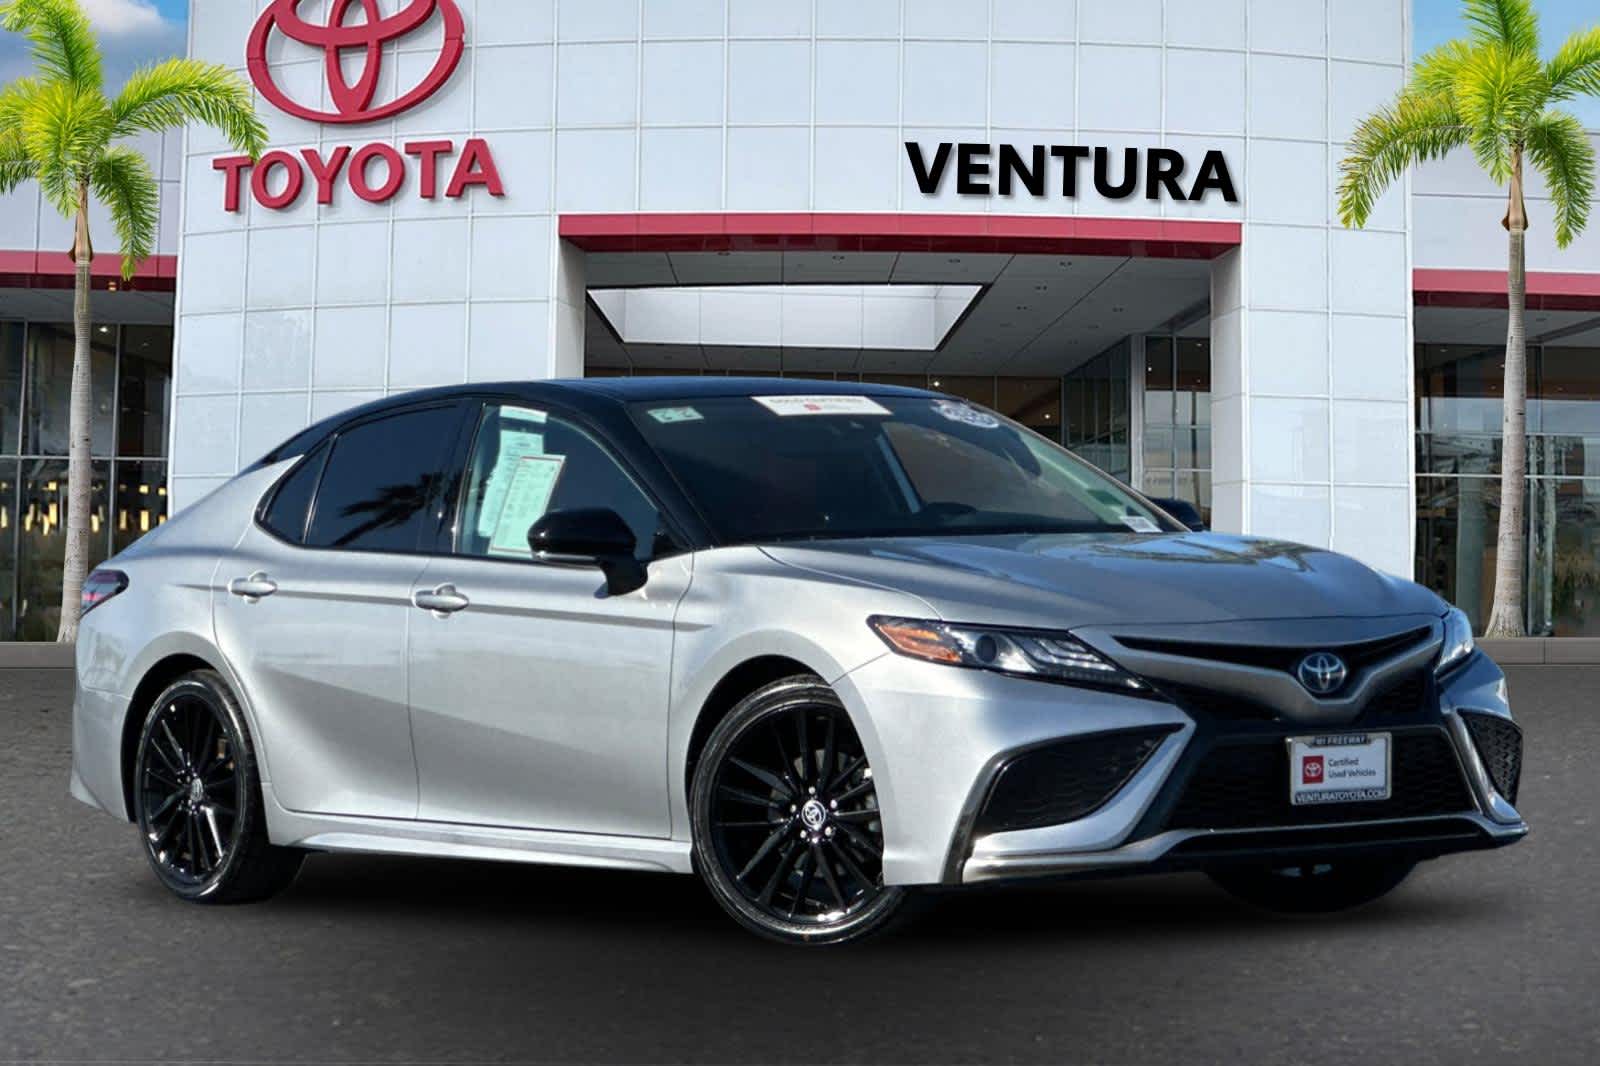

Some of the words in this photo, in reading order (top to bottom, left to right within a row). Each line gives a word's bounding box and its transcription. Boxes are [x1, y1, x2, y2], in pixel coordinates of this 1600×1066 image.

[212, 138, 505, 212] TOYOTA
[904, 142, 1238, 202] VENTURA
[1328, 757, 1359, 767] Certified
[1328, 769, 1346, 779] Used
[1348, 768, 1377, 777] Vehicles
[1295, 790, 1386, 803] VENTURATOYOTA.COM
